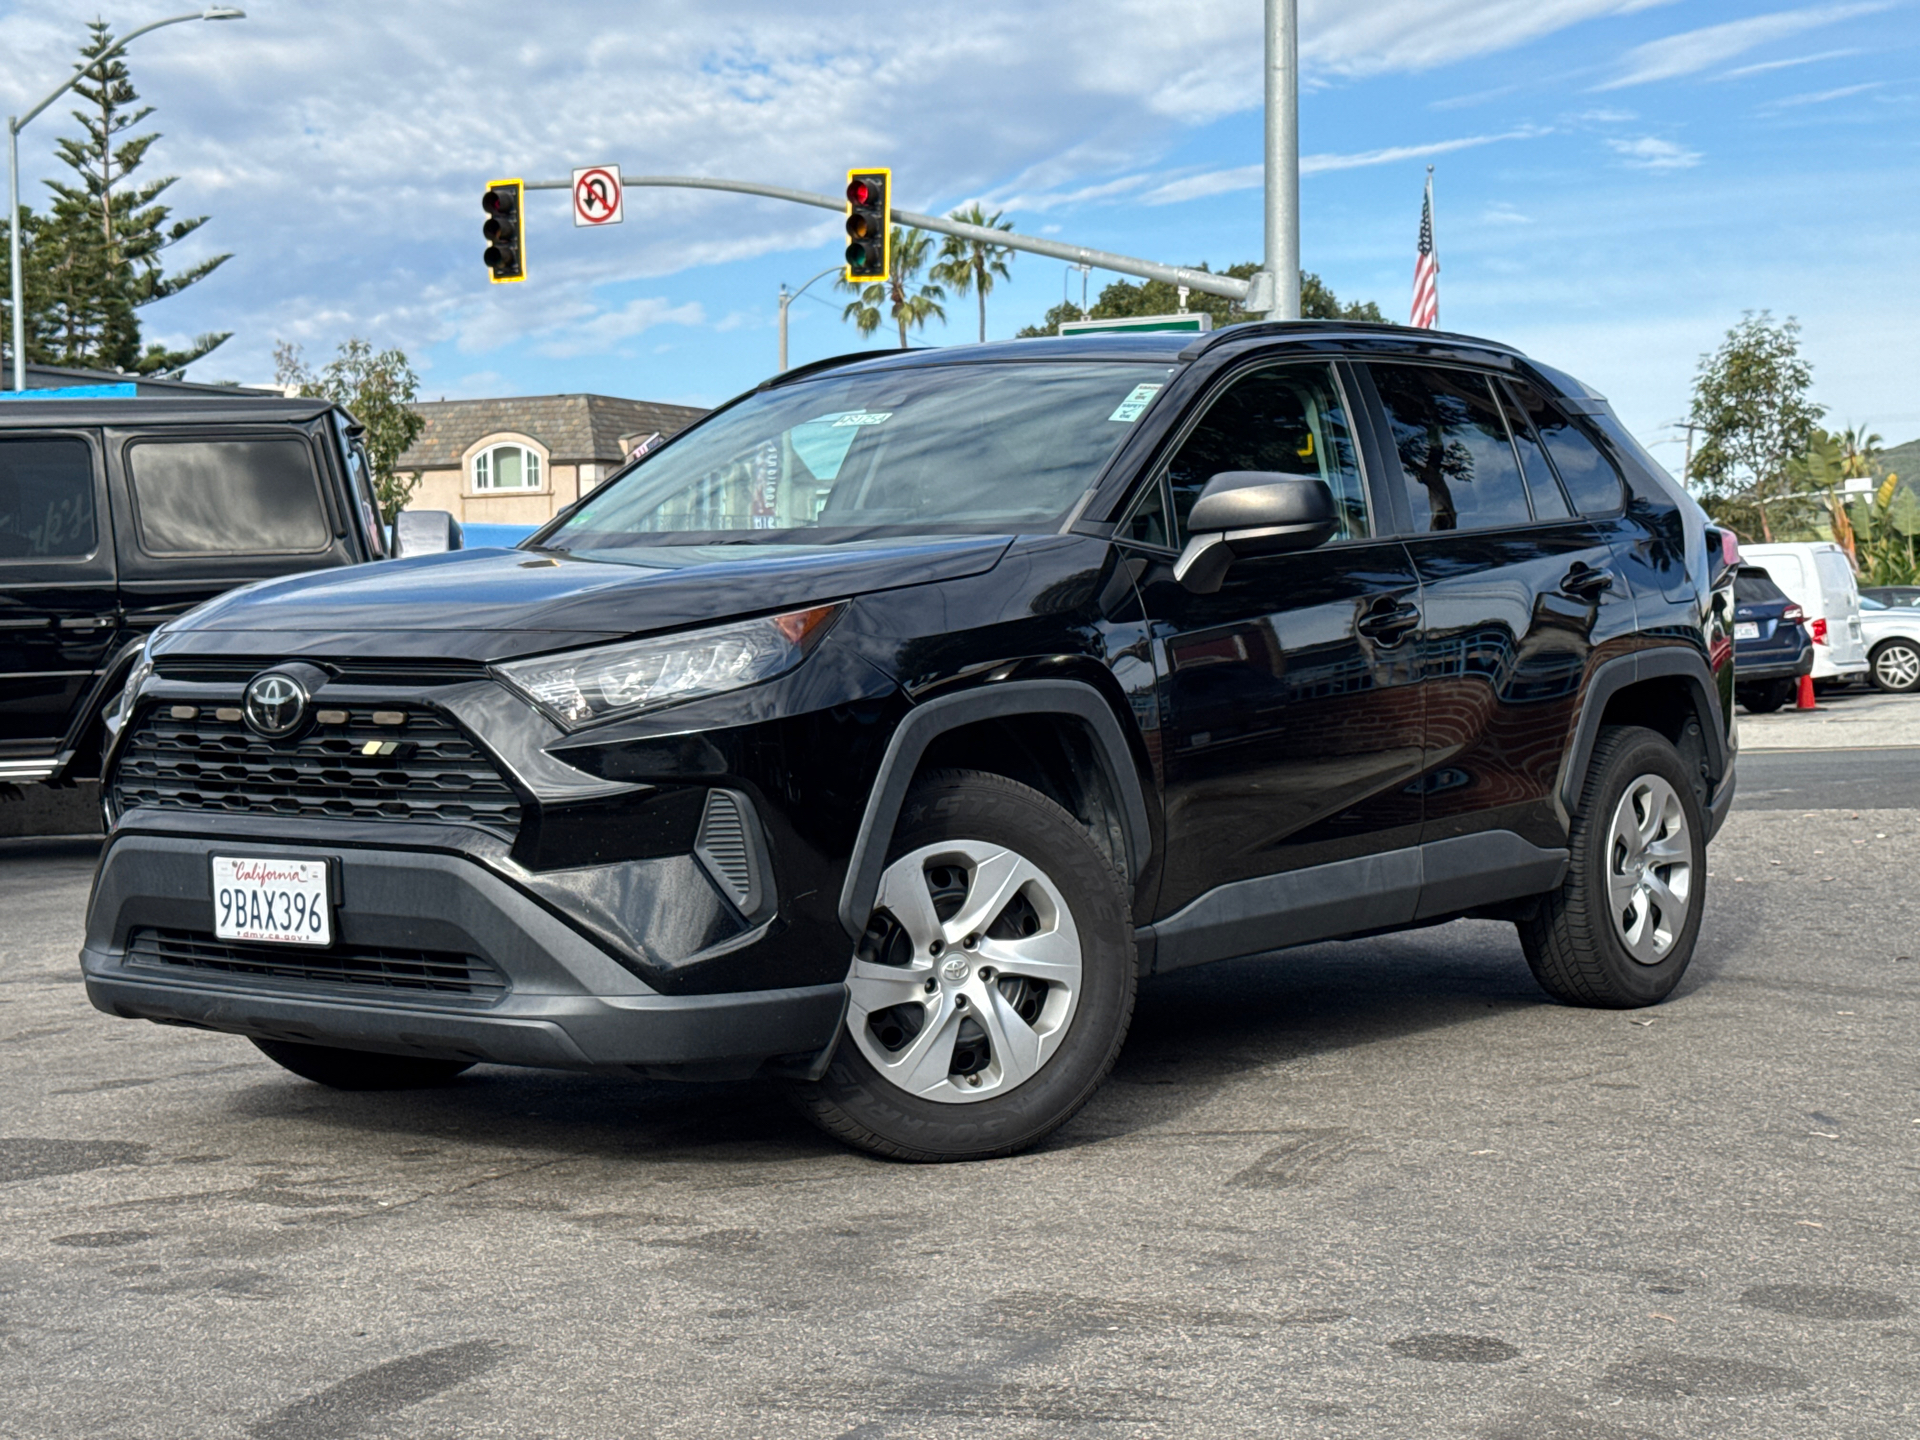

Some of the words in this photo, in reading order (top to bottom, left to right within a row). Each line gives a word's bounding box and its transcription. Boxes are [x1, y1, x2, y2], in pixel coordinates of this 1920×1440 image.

[235, 861, 308, 887] California
[930, 795, 1114, 920] STARFIRE
[219, 887, 322, 933] 9BAX396
[829, 1062, 1007, 1144] SOLARUS
